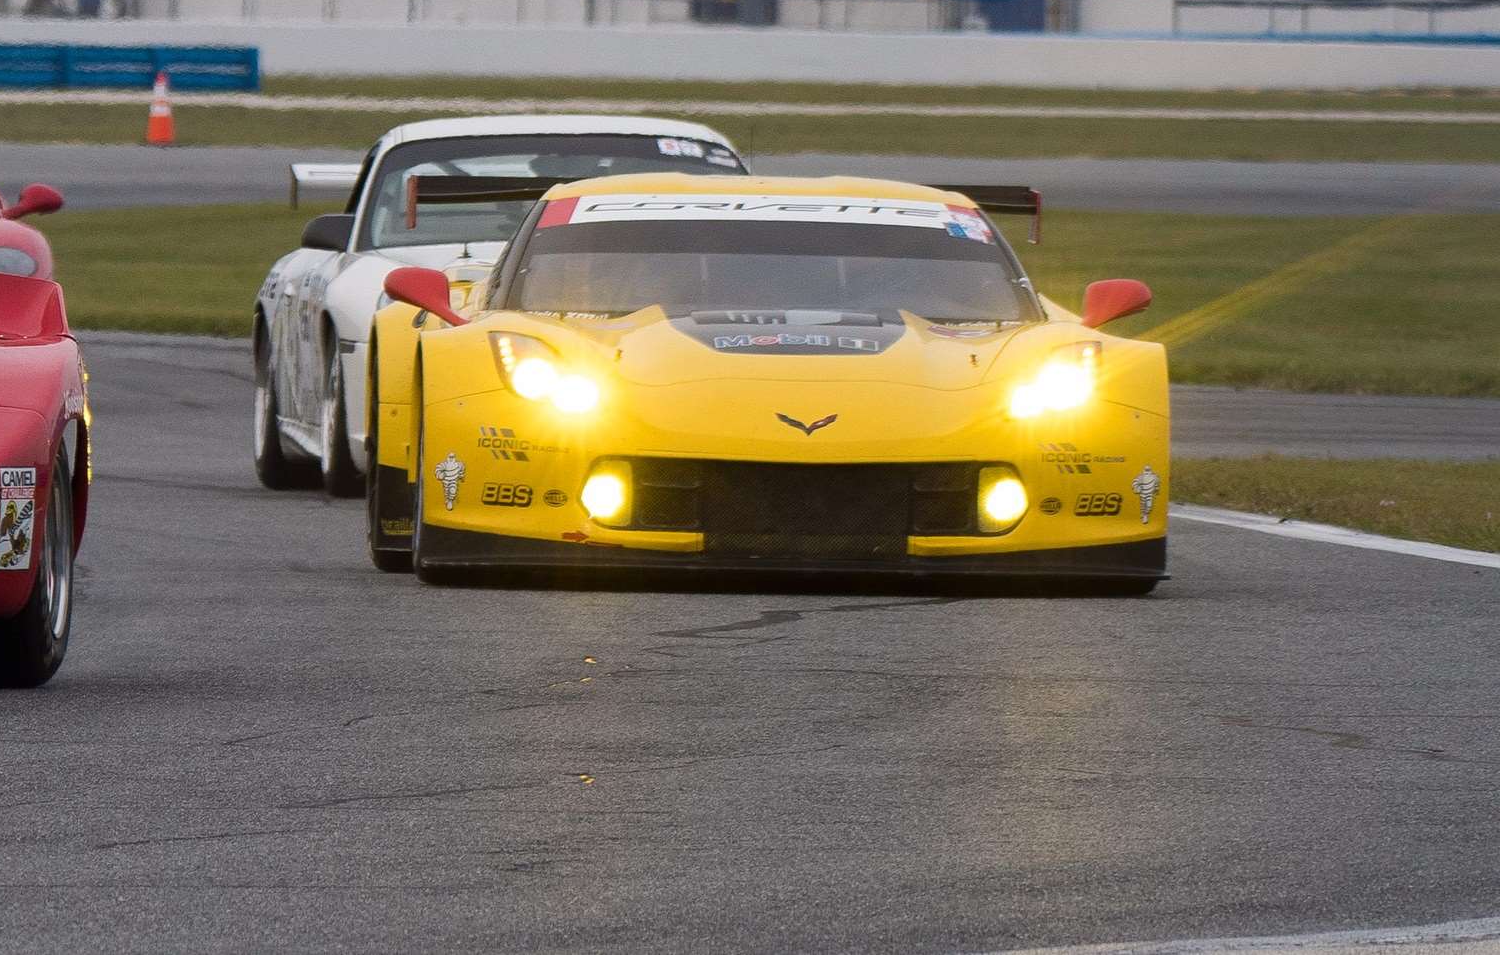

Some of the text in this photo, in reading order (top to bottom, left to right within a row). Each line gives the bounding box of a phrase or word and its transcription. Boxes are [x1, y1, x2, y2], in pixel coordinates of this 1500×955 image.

[584, 202, 942, 218] CORVETTE
[714, 333, 878, 352] Mobil 1
[477, 437, 530, 451] ICONIC
[1041, 453, 1092, 463] ICONIC
[1, 471, 35, 487] CAMEL
[482, 482, 533, 507] BBS
[1074, 493, 1122, 516] BBS
